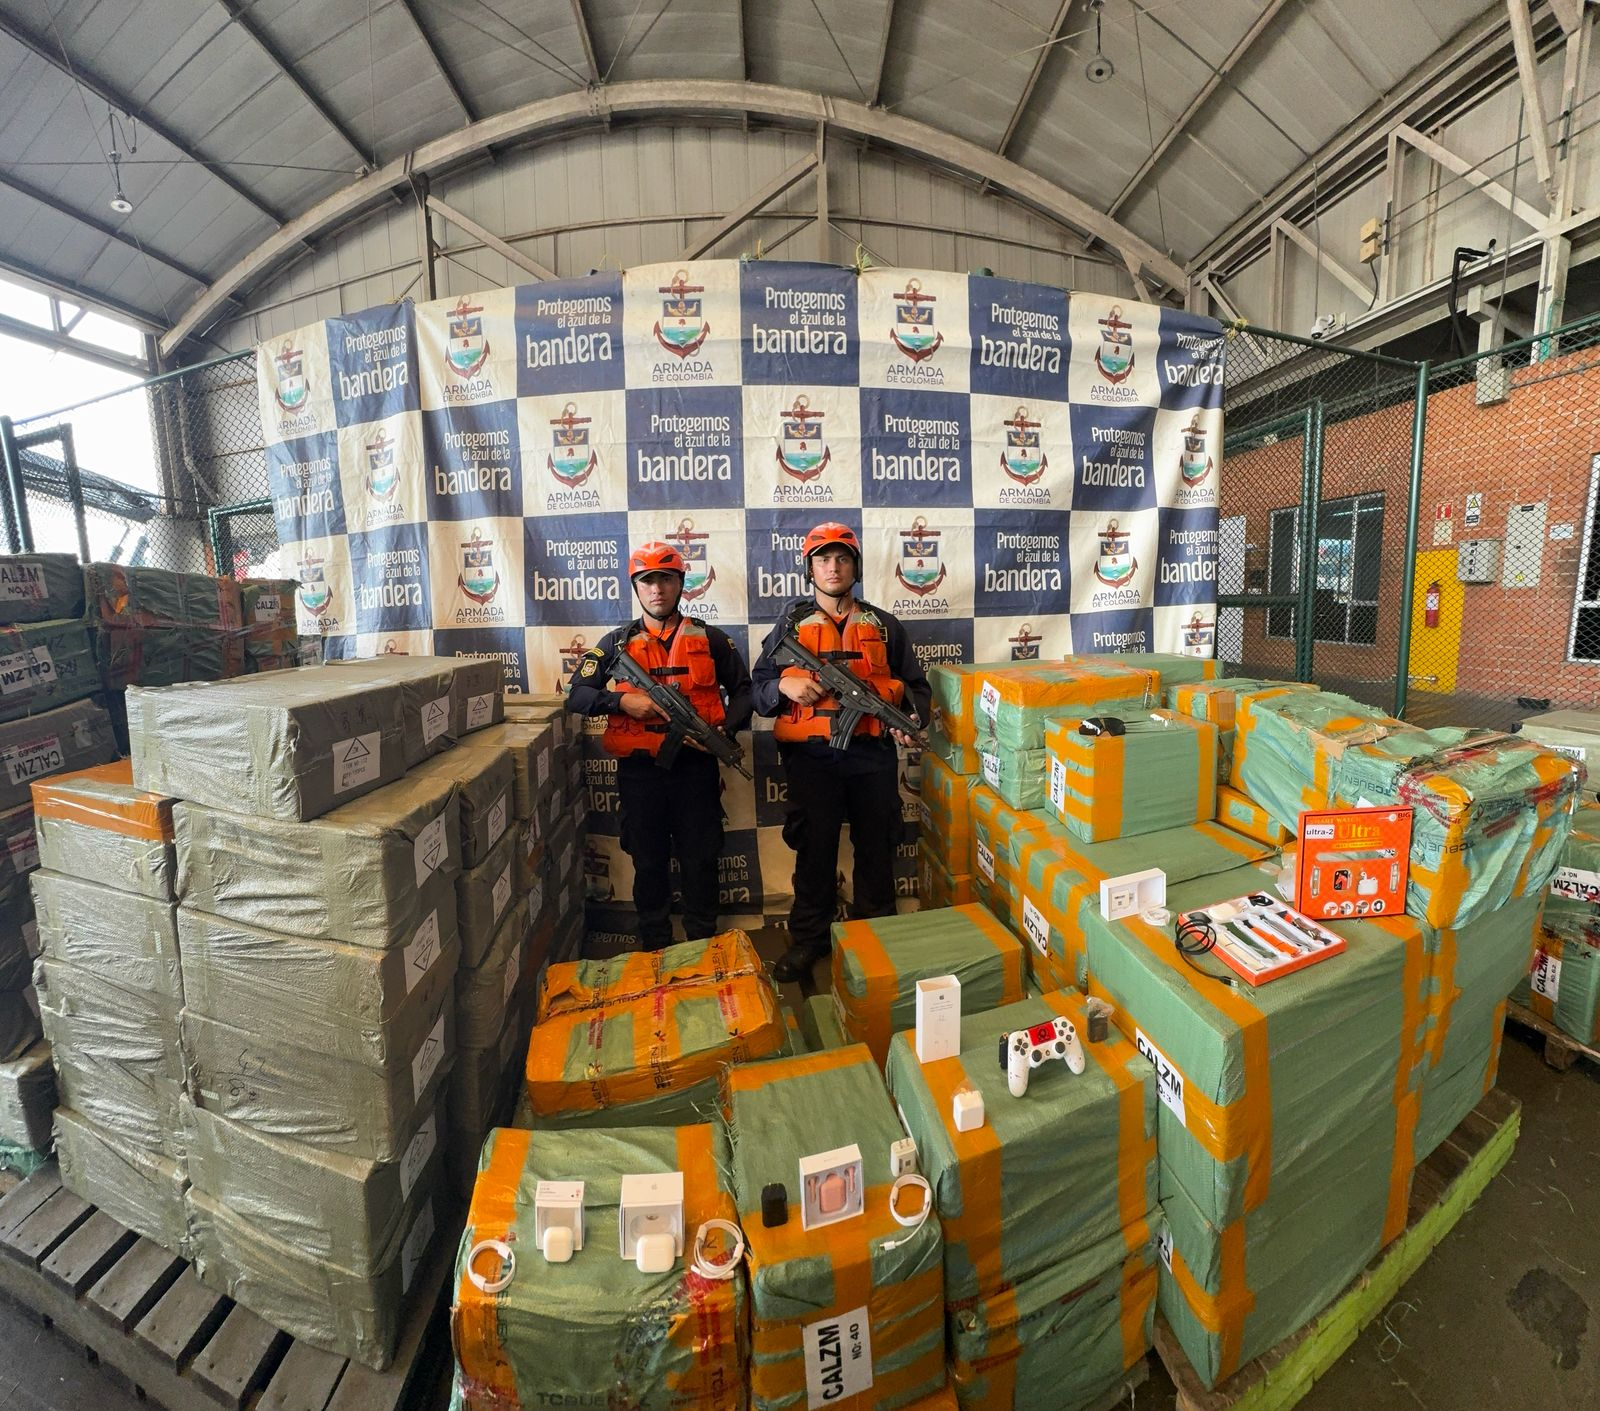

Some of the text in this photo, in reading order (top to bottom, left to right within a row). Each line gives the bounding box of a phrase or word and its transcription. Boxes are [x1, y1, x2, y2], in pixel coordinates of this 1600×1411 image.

[537, 296, 612, 317] Protegemos
[765, 286, 845, 313] Protegemos
[557, 313, 611, 328] el azul de la
[790, 311, 846, 326] el azul de la
[991, 302, 1058, 331] Protegemos
[345, 325, 406, 354] Protegemos
[752, 323, 847, 354] bandera
[1012, 328, 1061, 341] el azul de la
[365, 342, 407, 363] el azul de la
[526, 327, 612, 369] bandera
[980, 334, 1061, 373] bandera
[653, 361, 713, 373] ARMADA
[887, 365, 944, 377] ARMADA
[339, 361, 408, 400] bandera
[666, 373, 713, 381] COLOMBIA
[887, 375, 945, 385] DE COLOMBIA
[443, 379, 492, 395] ARMADA
[1091, 385, 1138, 397] ARMADA
[443, 390, 492, 402] DE COLOMBIA
[1102, 394, 1140, 402] COLOMBIA
[279, 414, 316, 429] ARMADA
[651, 414, 730, 435] Protegemos
[884, 414, 959, 437] Protegemos
[444, 430, 509, 450] Protegemos
[674, 433, 730, 448] el azul de la
[908, 435, 960, 450] el azul de la
[1091, 427, 1145, 446] Protegemos
[462, 448, 510, 462] el azul de la
[1110, 445, 1144, 460] el azul de la
[280, 457, 331, 477] Protegemos
[637, 447, 731, 482] bandera
[872, 447, 960, 481] bandera
[1081, 455, 1145, 487] bandera
[434, 460, 511, 495] bandera
[547, 490, 600, 503] ARMADA
[773, 485, 833, 495] ARMADA
[1000, 488, 1050, 498] ARMADA
[276, 488, 335, 521] bandera
[547, 500, 600, 511] DE COLOMBIA
[546, 540, 617, 559] Protegemos
[772, 533, 806, 551] Prote
[997, 532, 1060, 552] Protegemos
[1186, 544, 1210, 556] el azul
[367, 549, 419, 569] Protegemos
[567, 556, 619, 570] el azul de la
[795, 554, 803, 565] el
[1017, 550, 1059, 563] el azul de la
[385, 566, 401, 578] azul
[403, 566, 412, 577] de
[413, 565, 421, 576] la
[984, 563, 1062, 592] bandera
[1160, 554, 1218, 584] bander
[534, 570, 620, 601] bandera
[360, 579, 422, 610] bandera
[893, 598, 949, 608] ARMADA
[1092, 589, 1140, 601] ARMADA
[1104, 598, 1140, 606] COLOMBIA
[456, 607, 504, 617] ARMADA
[679, 603, 718, 613] MADA
[302, 617, 339, 628] ARMADA
[468, 615, 505, 623] COLOMBIA
[1093, 630, 1146, 648] Protegemos
[912, 643, 962, 661] tegemos
[513, 666, 521, 679] la
[14, 750, 61, 779] CALZM
[1306, 828, 1334, 836] ultra-2
[1338, 823, 1381, 839] Ultra
[1553, 879, 1598, 896] CALZM
[1024, 912, 1047, 950] CALZM
[1536, 954, 1549, 993] CALZM
[1138, 1037, 1181, 1100] CALZM
[849, 1323, 862, 1360] NO: 40
[818, 1324, 844, 1400] CALZM
